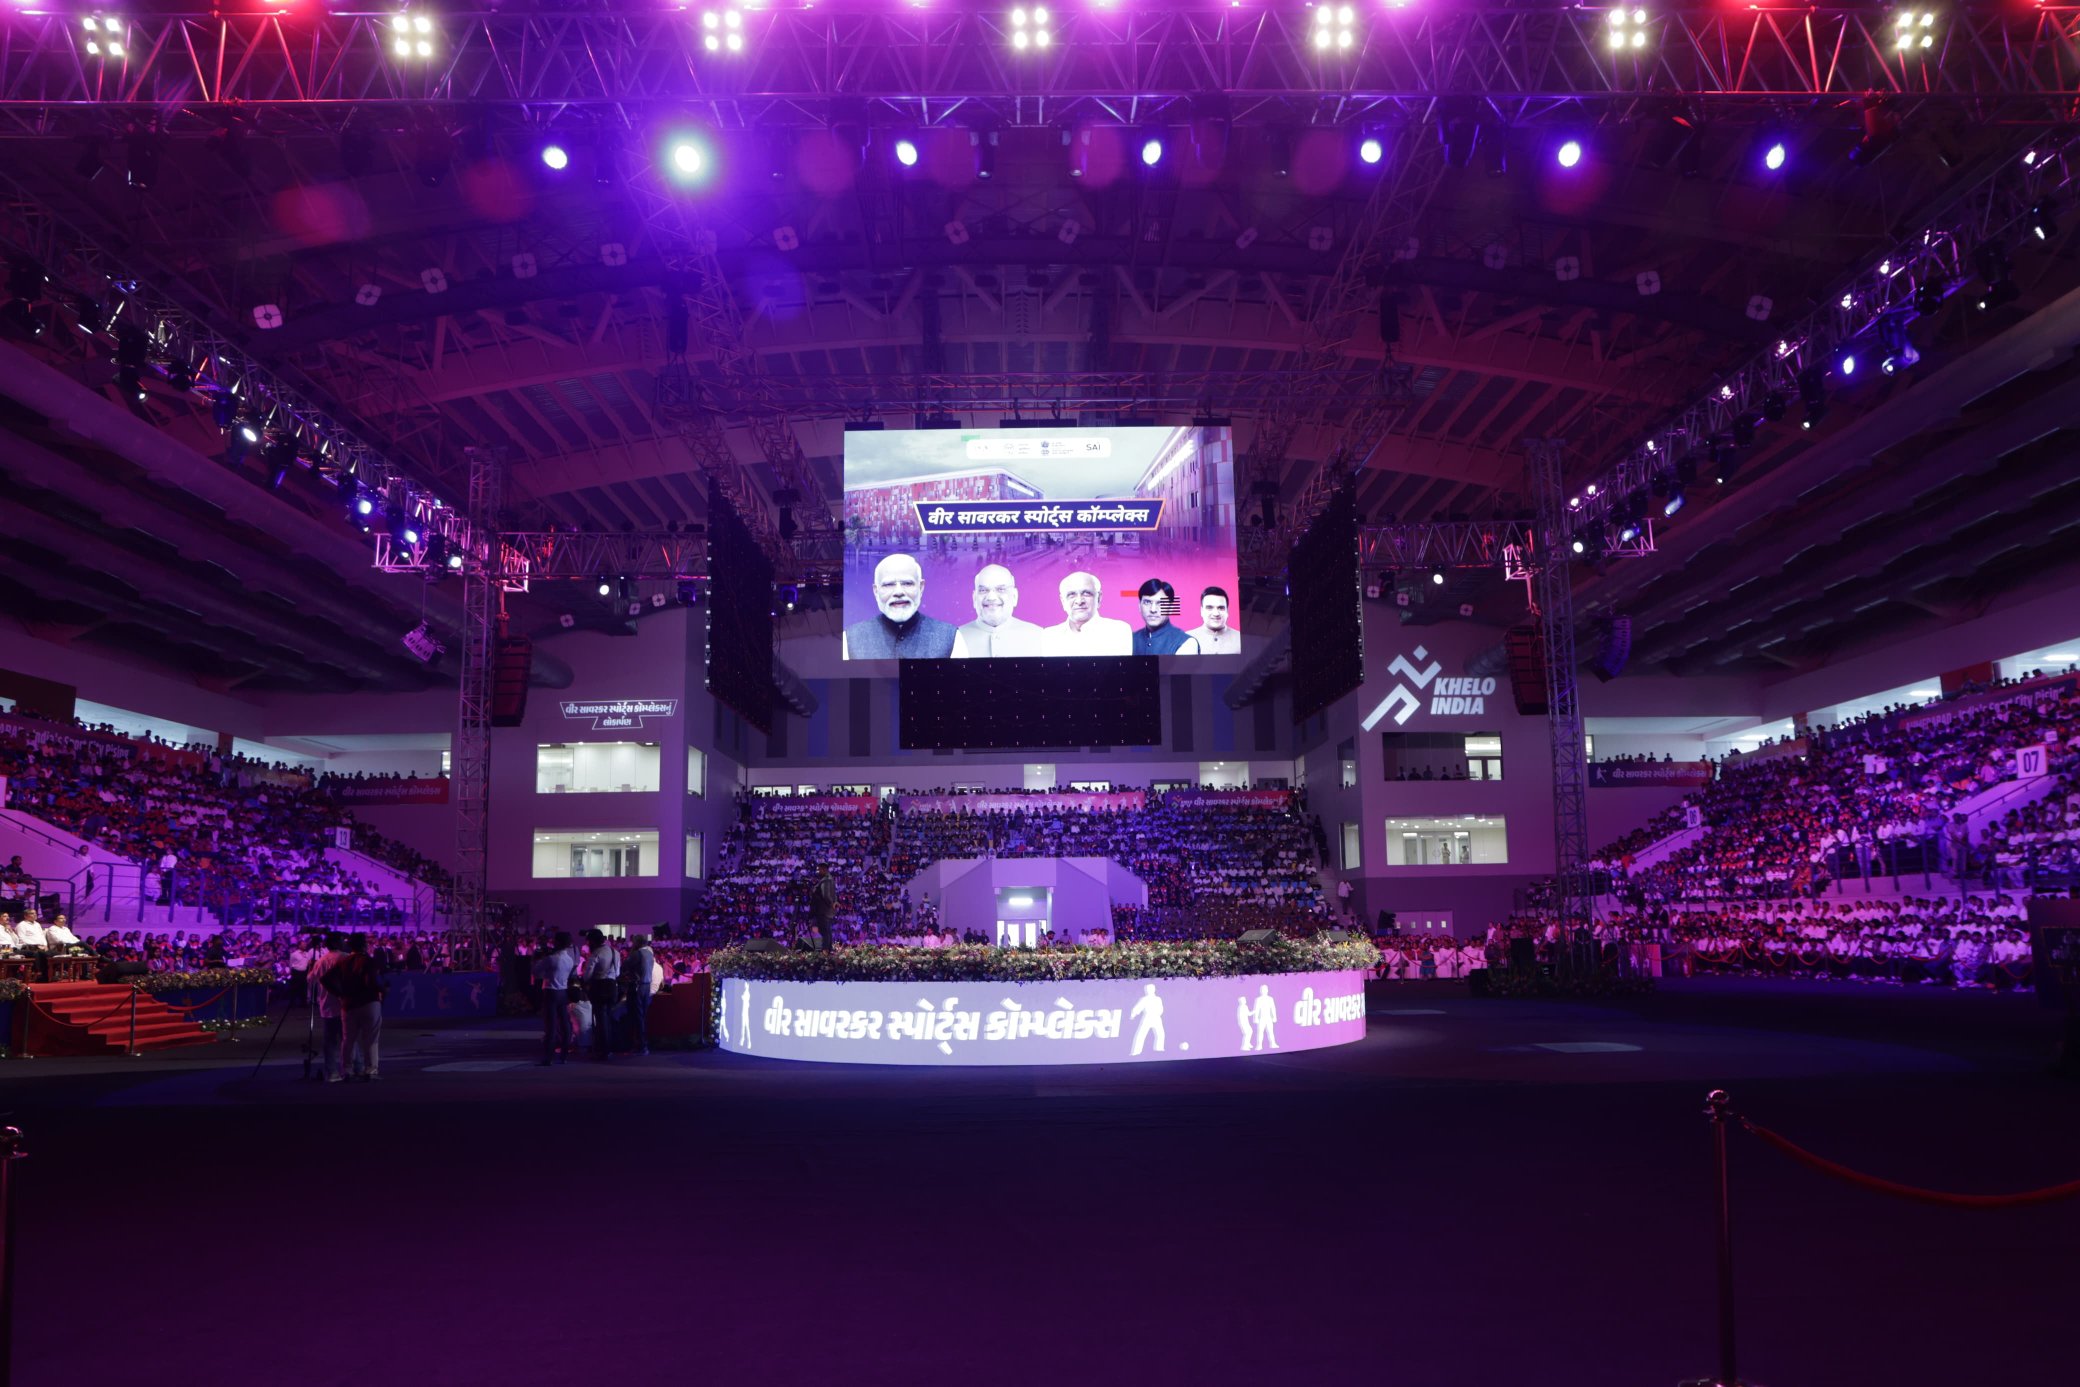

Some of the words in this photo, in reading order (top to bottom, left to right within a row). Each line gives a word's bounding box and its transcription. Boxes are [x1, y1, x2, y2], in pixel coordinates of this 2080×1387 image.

[928, 507, 954, 525] वीर
[958, 510, 1021, 524] सावरकर
[1024, 505, 1074, 528] स्पोर्ट्स
[1076, 504, 1149, 523] कॉम्प्लेक्स
[1433, 677, 1496, 695] KHELO
[565, 703, 578, 714] વીર
[579, 705, 608, 714] સાવરકર
[1430, 697, 1484, 715] INDIA
[2023, 751, 2039, 773] 07
[340, 831, 347, 846] 13
[1294, 987, 1322, 1027] વીર
[764, 995, 792, 1036] વીર
[794, 1008, 883, 1040] સાવરકર
[886, 997, 980, 1056] સ્પોર્ટ્સ
